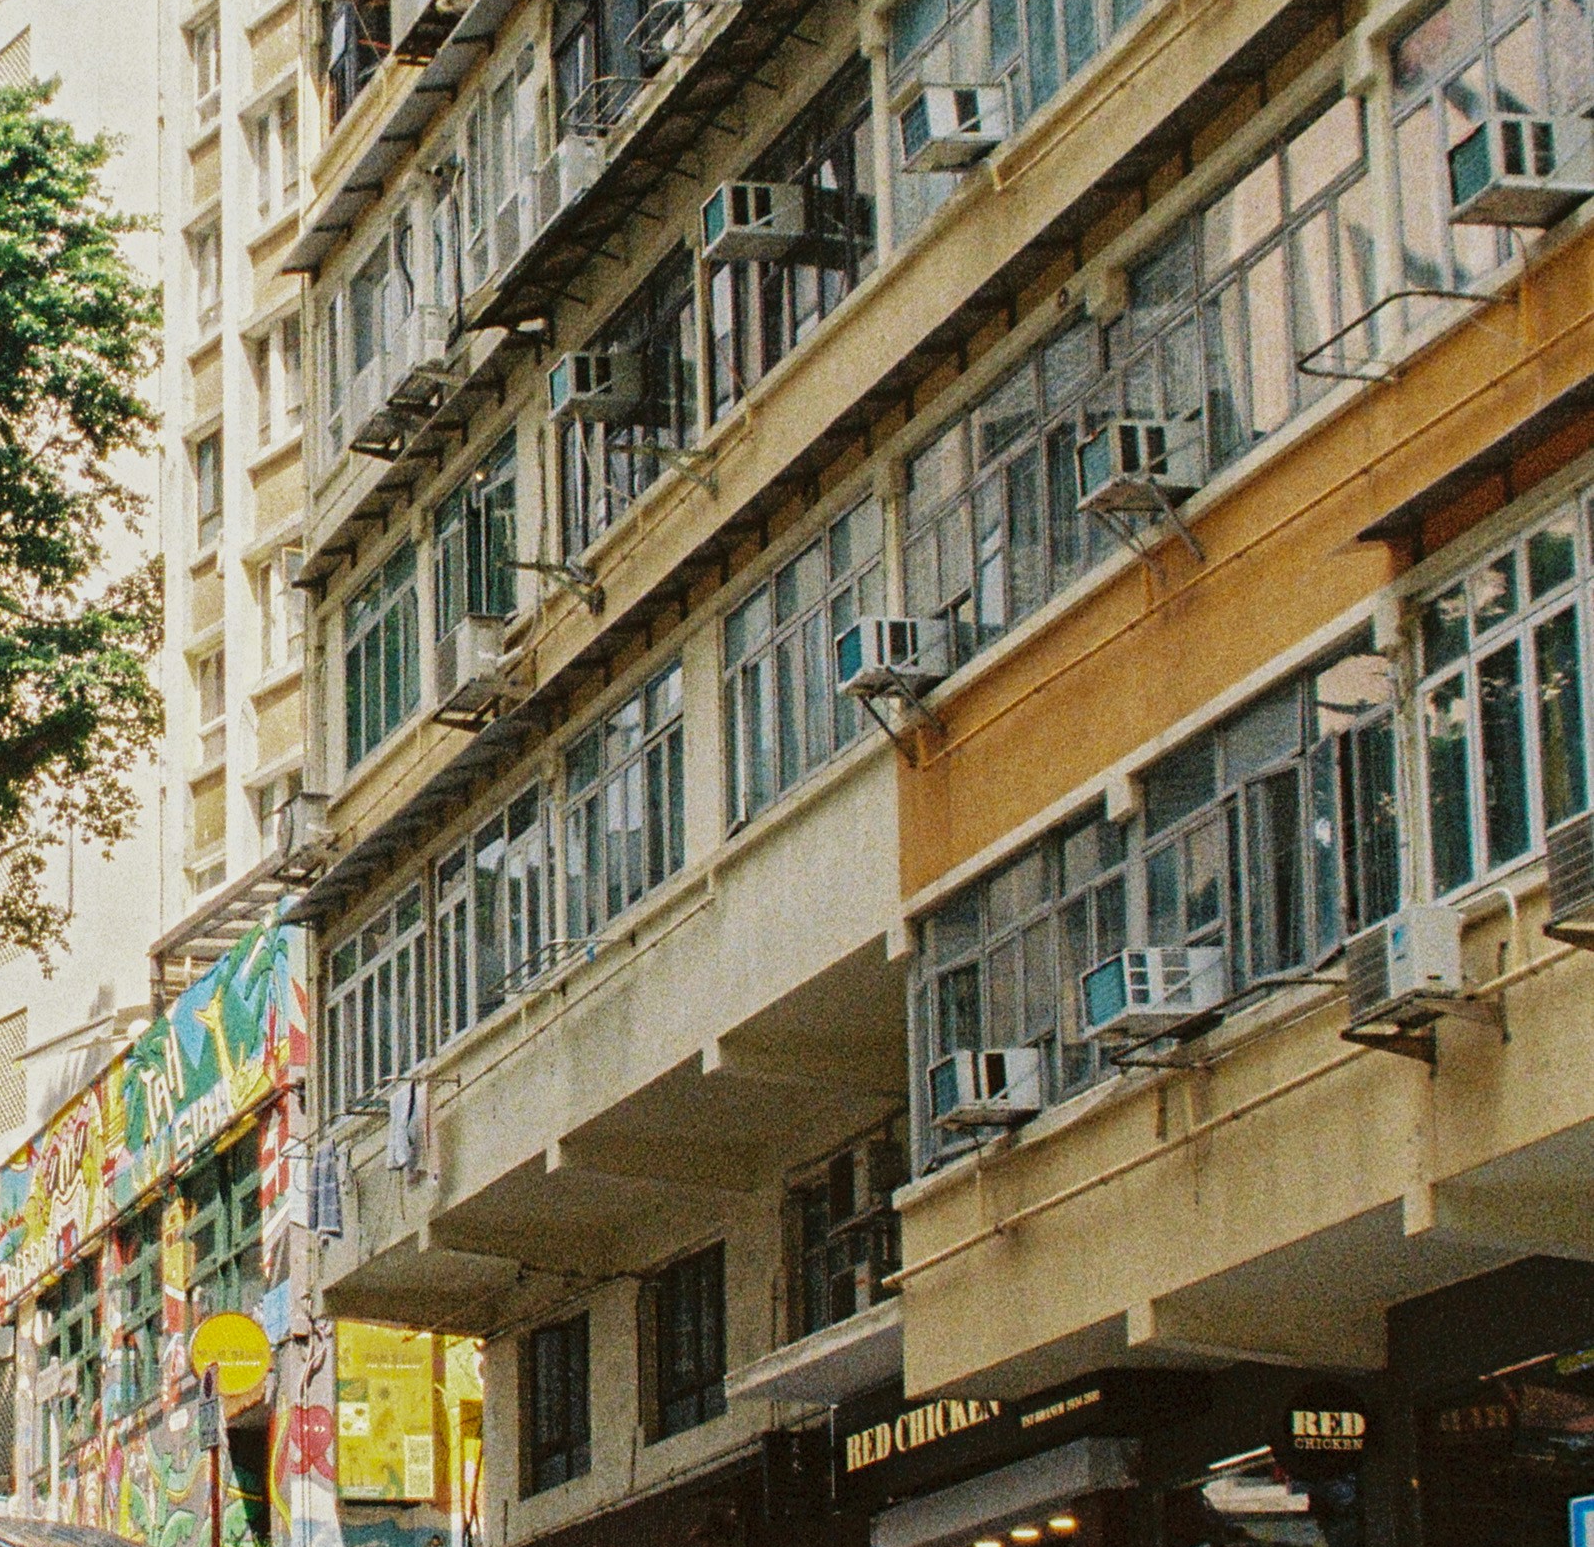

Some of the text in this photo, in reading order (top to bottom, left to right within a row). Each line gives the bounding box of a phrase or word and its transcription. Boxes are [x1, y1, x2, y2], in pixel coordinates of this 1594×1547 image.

[846, 1422, 892, 1473] RED
[895, 1399, 1001, 1452] CHICKEN
[1292, 1410, 1366, 1437] RED
[1294, 1437, 1364, 1451] CHICKEN
